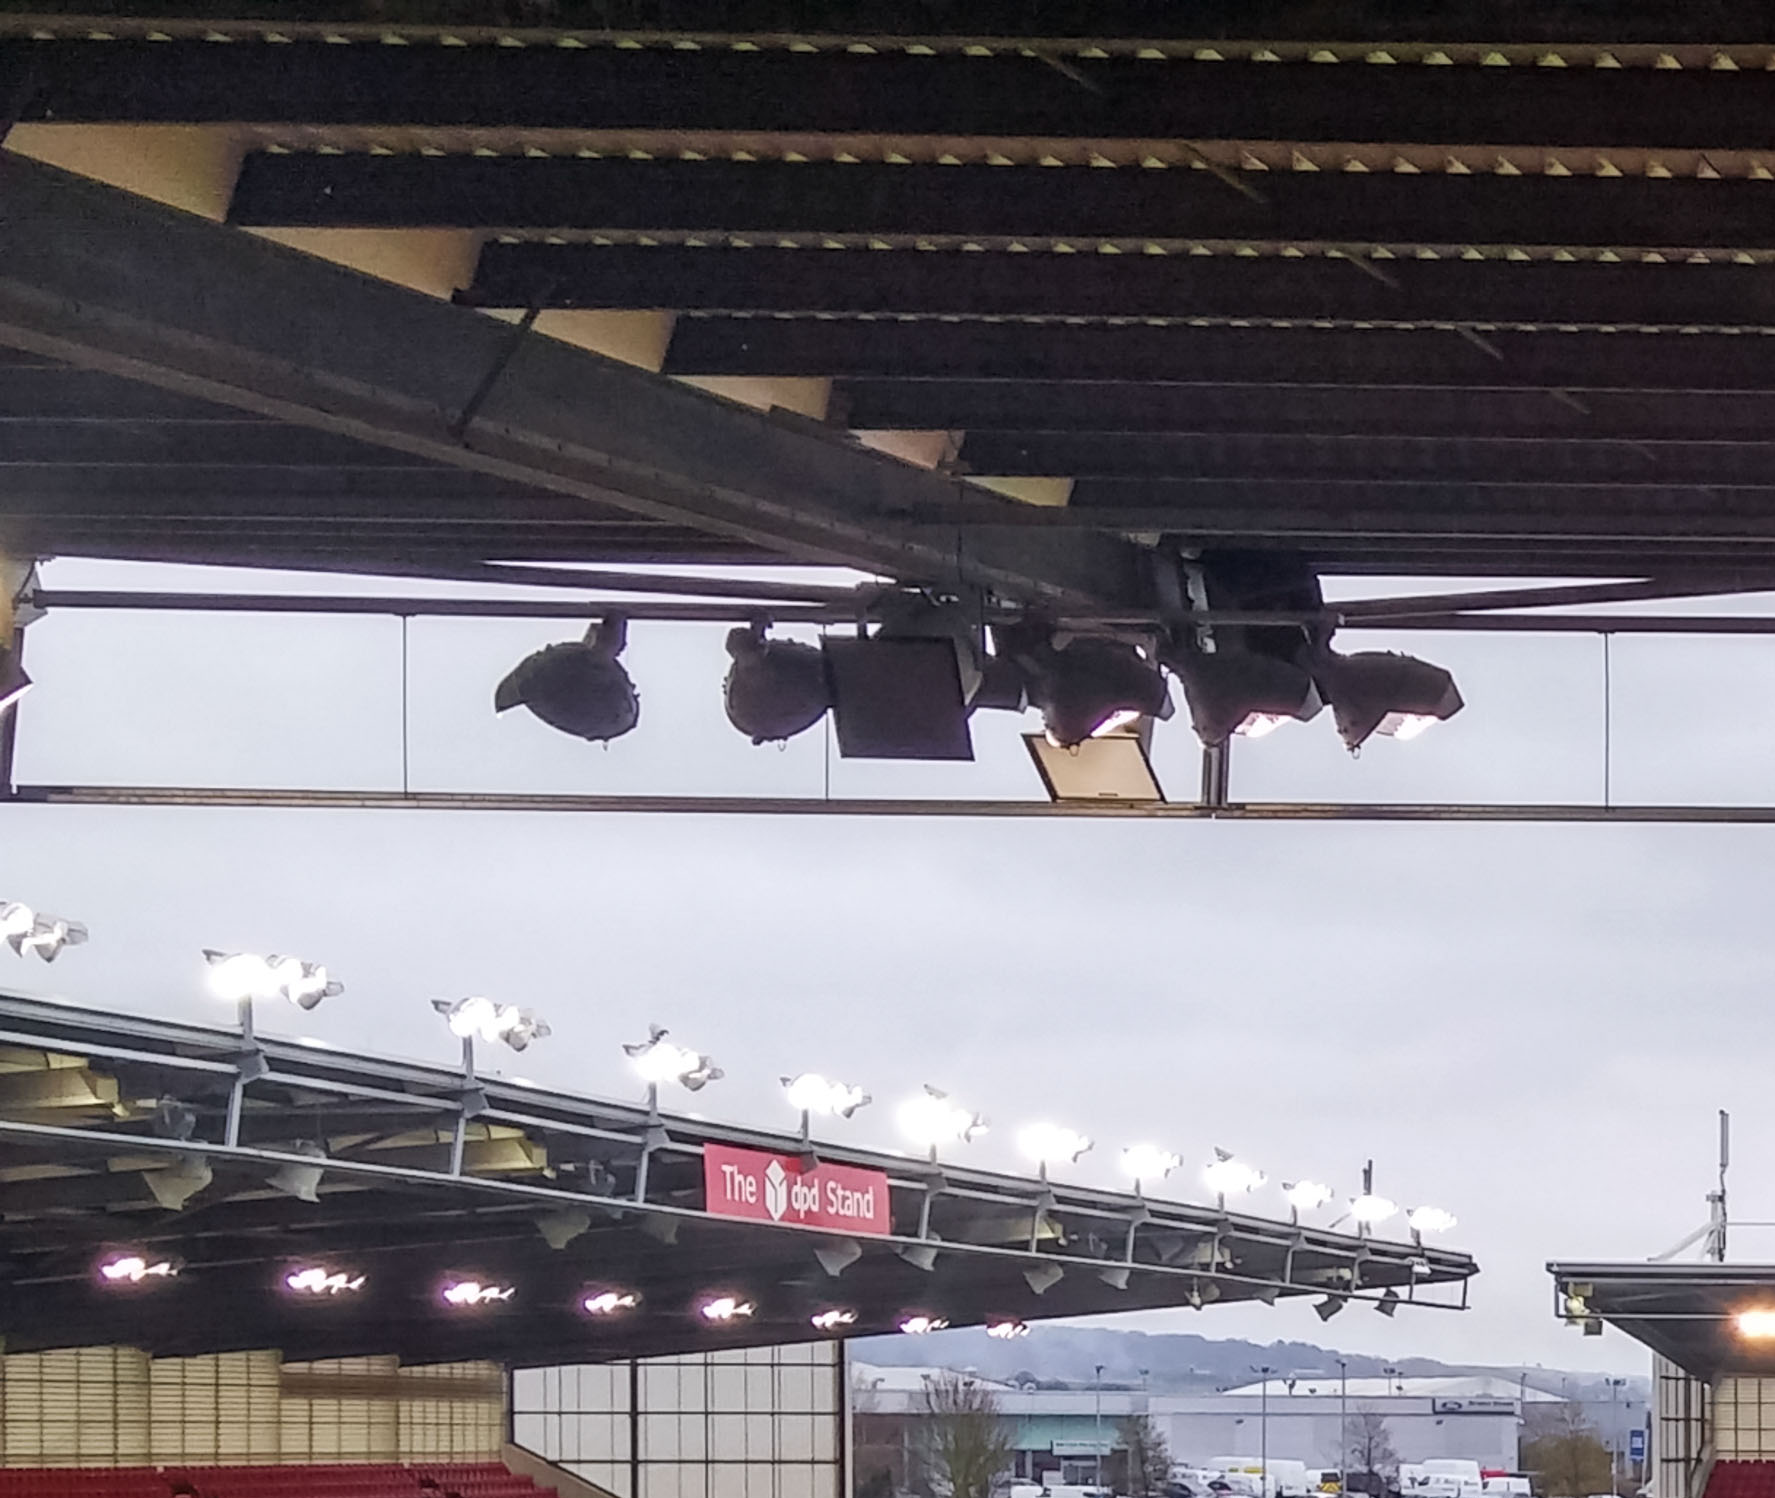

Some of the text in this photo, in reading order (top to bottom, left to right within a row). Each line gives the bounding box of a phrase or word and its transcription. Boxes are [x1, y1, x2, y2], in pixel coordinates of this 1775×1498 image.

[721, 1164, 874, 1219] The dpd Stand
